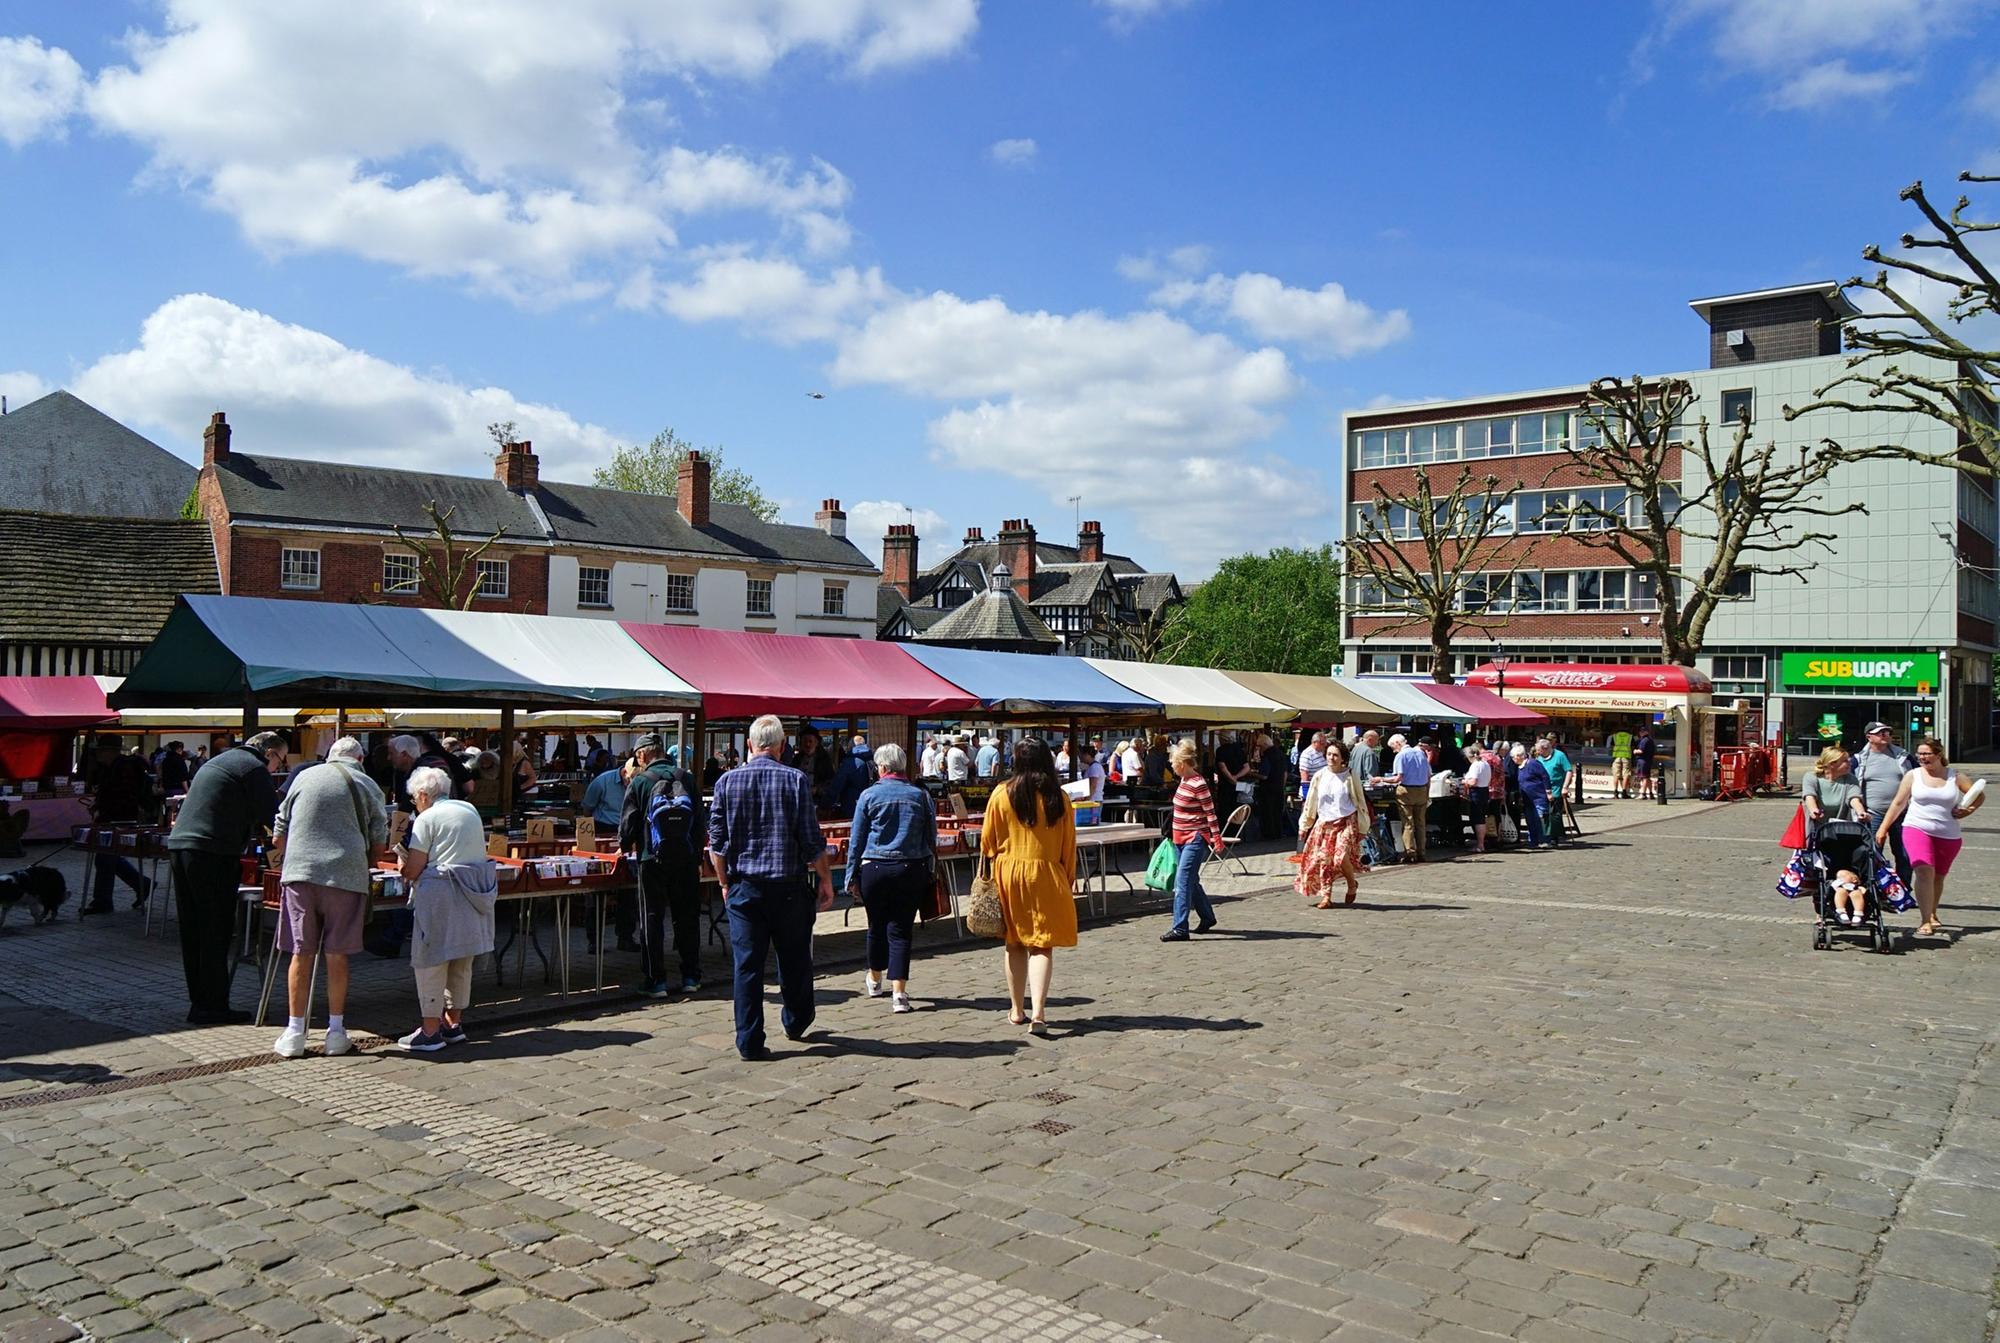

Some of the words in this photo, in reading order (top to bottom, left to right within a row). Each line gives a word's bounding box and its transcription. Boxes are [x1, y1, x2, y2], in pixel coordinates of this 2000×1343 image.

[1805, 660, 1915, 679] SUBWAY
[1515, 696, 1548, 704] Jacket
[1551, 697, 1596, 705] Potatoes
